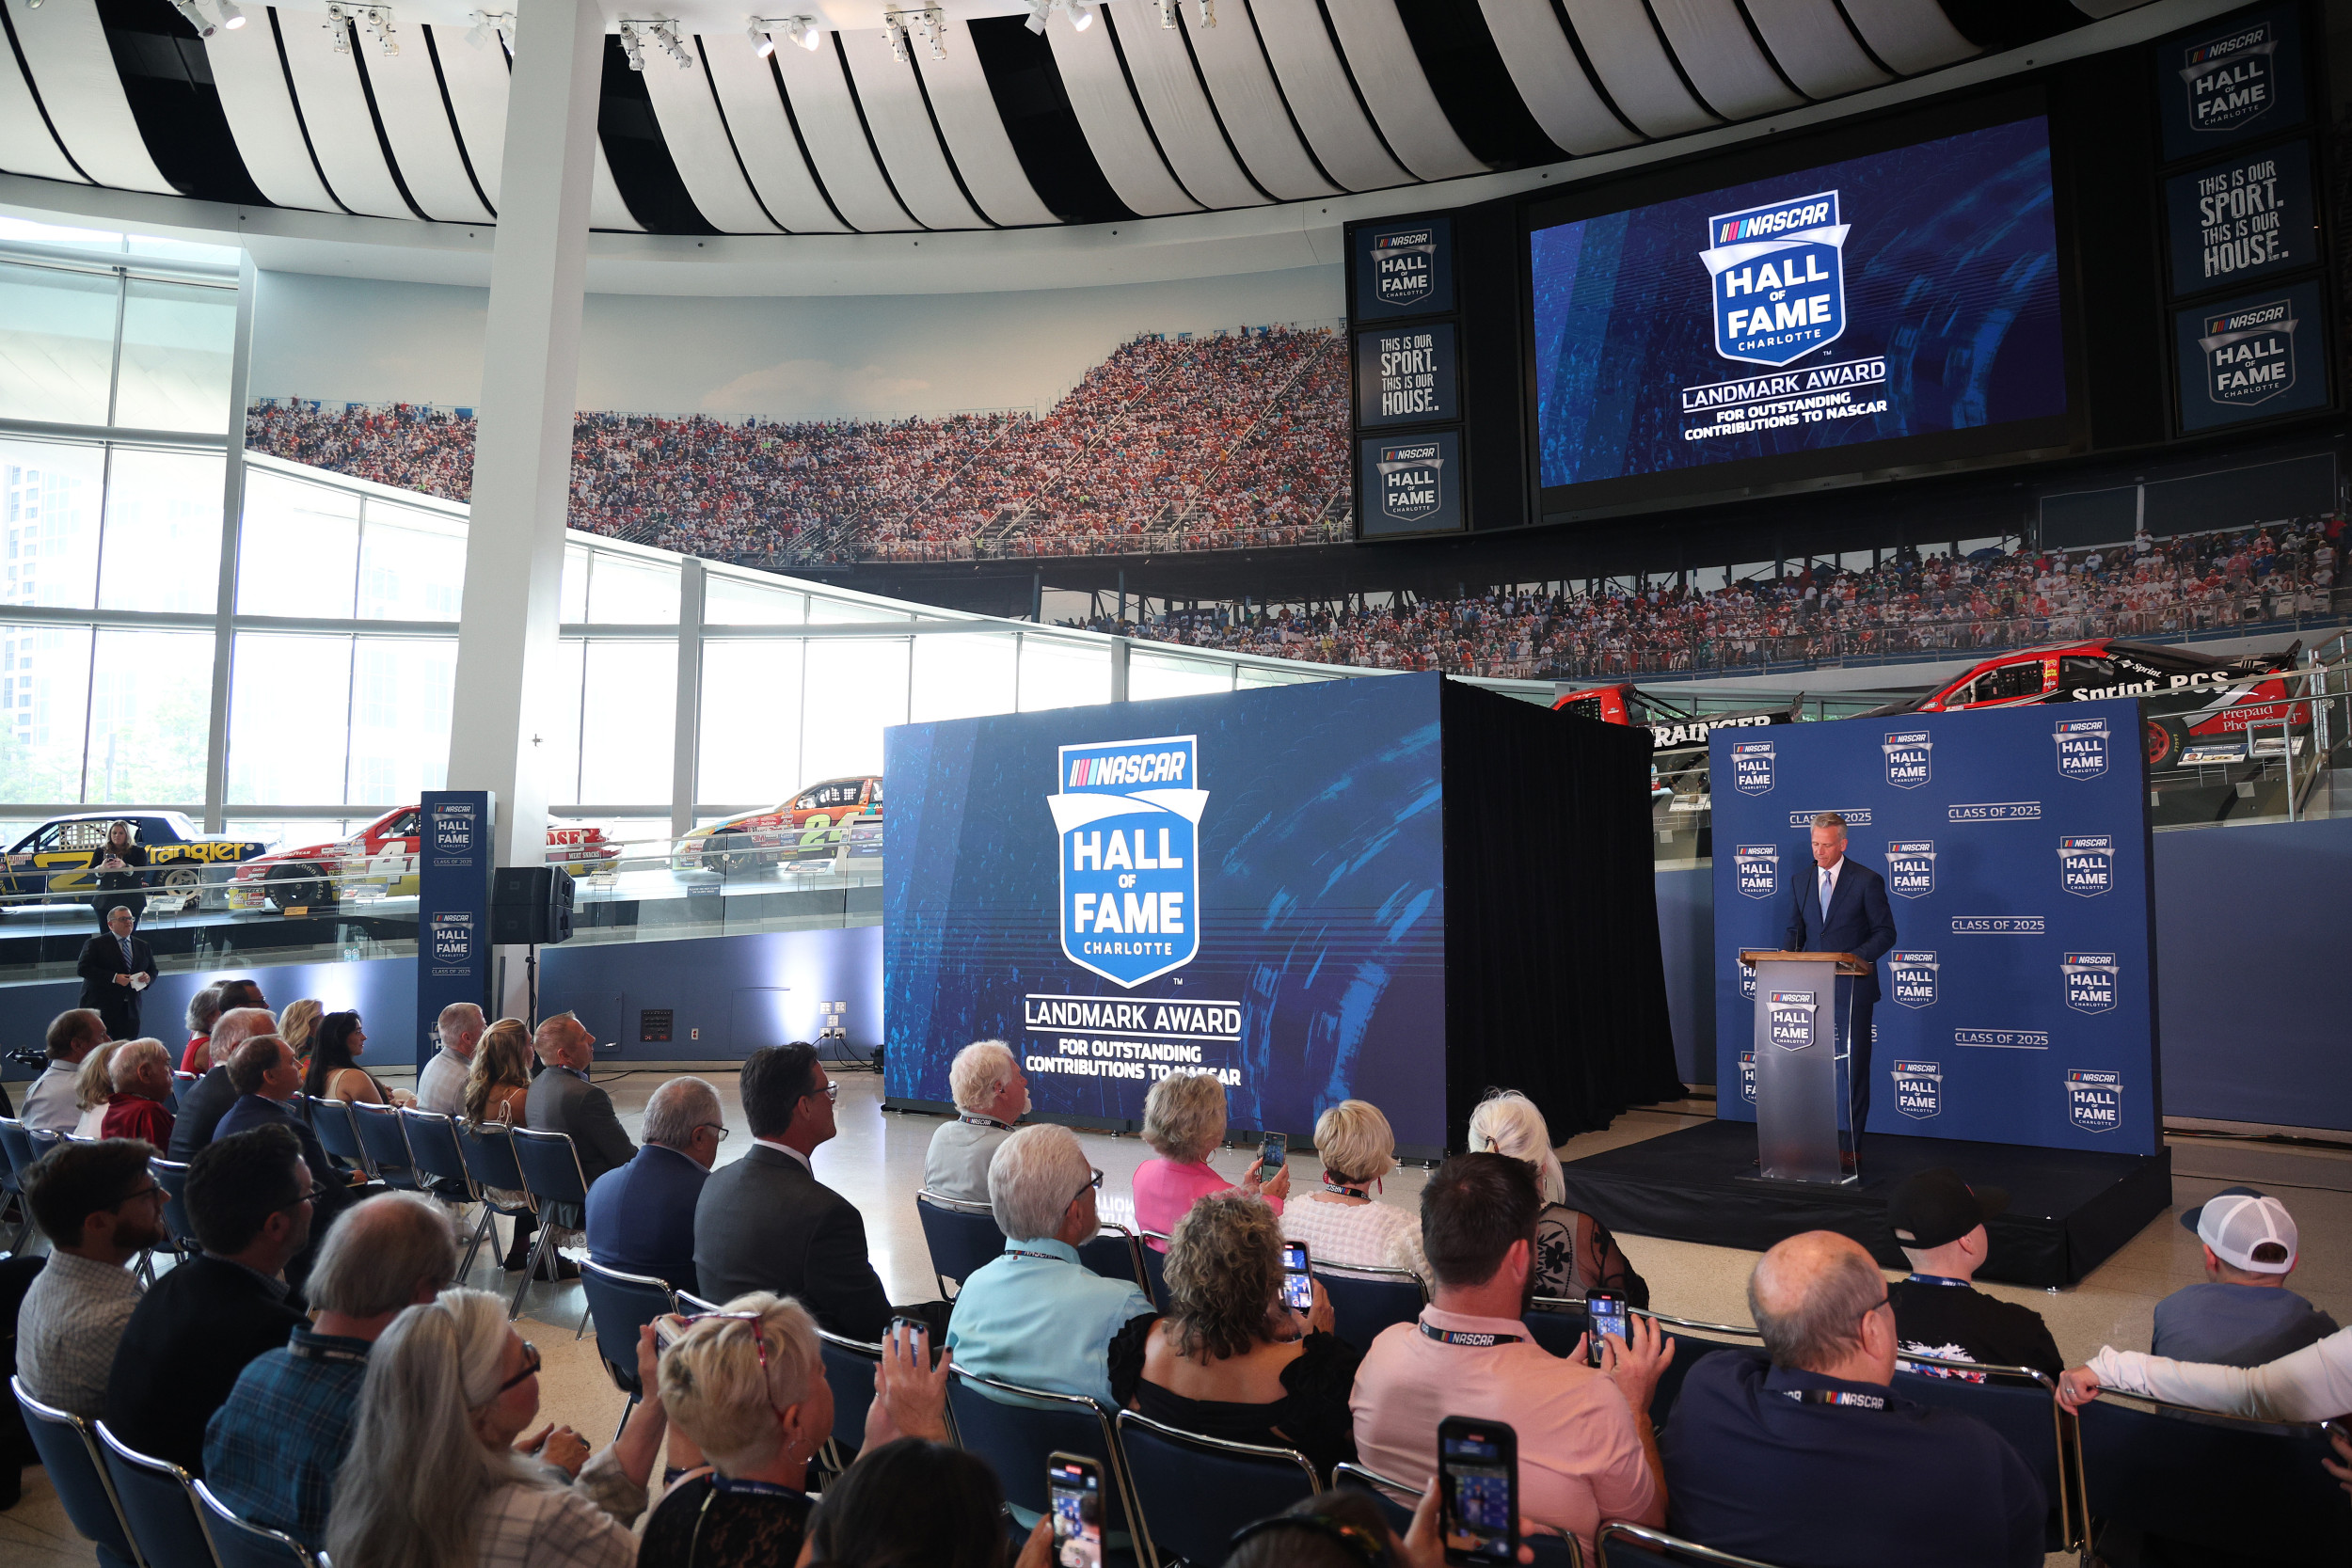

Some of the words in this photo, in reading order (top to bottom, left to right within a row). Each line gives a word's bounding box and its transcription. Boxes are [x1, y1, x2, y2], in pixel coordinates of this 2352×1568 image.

[2209, 30, 2263, 57] NASCAR
[2196, 62, 2264, 95] HALL
[2225, 84, 2235, 93] OF
[2198, 83, 2265, 119] FAME
[2203, 103, 2258, 125] CHARLOTTE
[2198, 174, 2227, 196] THIS
[2232, 169, 2244, 189] IS
[2249, 160, 2277, 184] OUR
[2201, 178, 2283, 227] SPORT.
[1746, 202, 1828, 237] NASCAR
[2201, 220, 2231, 245] THIS
[2235, 216, 2249, 239] IS
[2251, 211, 2280, 233] OUR
[1391, 233, 1427, 246] NASCAR
[2203, 230, 2288, 277] HOUSE.
[1381, 257, 1426, 273] HALL
[1725, 255, 1828, 297] HALL
[1383, 275, 1427, 292] FAME
[1770, 291, 1786, 301] OF
[1728, 294, 1831, 339] FAME
[2229, 307, 2283, 331] NASCAR
[1380, 338, 1400, 353] THIS
[1404, 337, 1411, 350] IS
[1414, 334, 1432, 348] OUR
[1739, 329, 1821, 351] CHARLOTTE
[2216, 339, 2284, 367] HALL
[1381, 348, 1437, 376] SPORT.
[2245, 358, 2256, 367] OF
[1382, 376, 1401, 391] THIS
[1405, 376, 1413, 388] IS
[1415, 374, 1434, 388] OUR
[2217, 361, 2286, 391] FAME
[1683, 375, 1800, 409] LANDMARK
[1806, 362, 1885, 389] AWARD
[2224, 383, 2280, 398] CHARLOTTE
[1383, 388, 1438, 416] HOUSE.
[1717, 407, 1744, 423] FOR
[1748, 392, 1851, 418] OUTSTANDING
[1685, 413, 1799, 440] CONTRIBUTIONS
[1802, 410, 1822, 423] TO
[1826, 401, 1886, 420] NASCAR
[1398, 448, 1435, 459] NASCAR
[1388, 470, 1434, 487] HALL
[1389, 490, 1435, 506] FAME
[2133, 663, 2162, 677] Sprint
[2073, 679, 2159, 702] Sprint
[2170, 672, 2230, 695] PCS
[2223, 705, 2273, 720] Prepaid
[2070, 721, 2103, 732] NASCAR
[1898, 734, 1927, 744] NASCAR
[1745, 743, 1771, 753] NASCAR
[2062, 740, 2102, 752] HALL
[1890, 752, 1926, 763] HALL
[2063, 755, 2103, 768] FAME
[1096, 751, 1186, 784] NASCAR
[1739, 761, 1770, 772] HALL
[1891, 766, 1927, 777] FAME
[1739, 773, 1771, 784] FAME
[1845, 813, 1871, 822] 2025
[1948, 808, 1986, 818] CLASS
[1990, 807, 2006, 816] OF
[2010, 805, 2041, 816] 2025
[438, 821, 469, 830] HALL
[438, 834, 469, 843] FAME
[1073, 828, 1183, 870] HALL
[1741, 864, 1772, 873] HALL
[1894, 862, 1930, 871] HALL
[2066, 858, 2106, 868] HALL
[1119, 875, 1136, 888] OF
[1741, 879, 1773, 887] FAME
[1895, 877, 1930, 886] FAME
[2067, 873, 2107, 884] FAME
[1074, 892, 1184, 934] FAME
[1951, 920, 1990, 929] CLASS
[1994, 921, 2010, 929] OF
[2013, 920, 2044, 929] 2025
[1084, 942, 1172, 955] CHARLOTTE
[1897, 973, 1932, 983] HALL
[2071, 974, 2111, 987] HALL
[1897, 986, 1932, 997] FAME
[2071, 990, 2111, 1002] FAME
[1025, 1001, 1147, 1029] LANDMARK
[1154, 1006, 1241, 1034] AWARD
[1774, 1012, 1808, 1023] HALL
[1774, 1027, 1808, 1038] FAME
[1955, 1031, 1993, 1044] CLASS
[1996, 1035, 2013, 1043] OF
[2017, 1033, 2048, 1046] 2025
[1059, 1038, 1089, 1055] FOR
[1092, 1040, 1201, 1062] OUTSTANDING
[1026, 1056, 1145, 1079] CONTRIBUTIONS
[1149, 1064, 1170, 1081] TO
[1907, 1064, 1936, 1072] NASCAR
[2083, 1073, 2115, 1082] NASCAR
[1899, 1082, 1935, 1093] HALL
[1900, 1095, 1936, 1108] FAME
[2074, 1091, 2115, 1104] HALL
[2075, 1106, 2115, 1120] FAME
[1453, 1334, 1494, 1346] NASCAR
[1841, 1392, 1883, 1410] NASCAR
